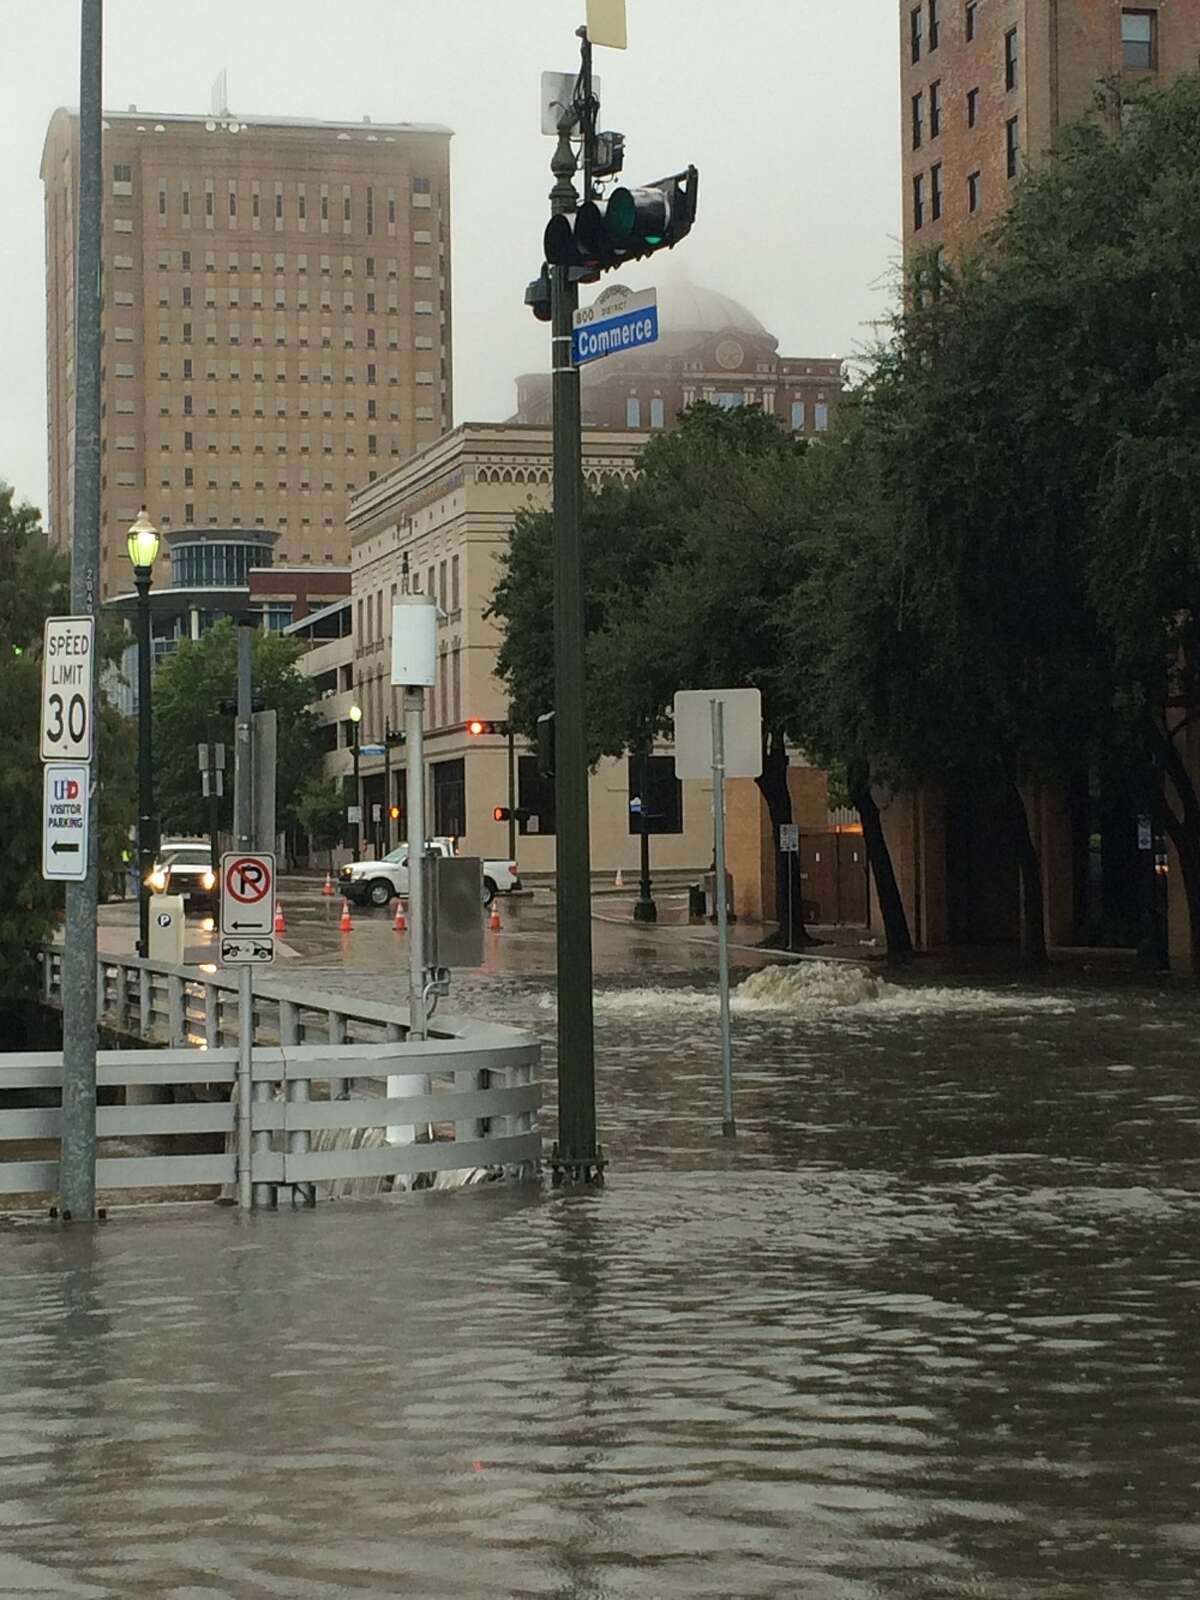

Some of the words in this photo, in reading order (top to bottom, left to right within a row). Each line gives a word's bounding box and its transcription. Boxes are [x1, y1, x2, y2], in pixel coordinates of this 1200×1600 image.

[576, 309, 594, 325] 800
[578, 318, 652, 356] Commerce
[49, 635, 89, 656] SPEED
[52, 664, 83, 685] LIMIT
[47, 693, 86, 743] 30
[50, 804, 82, 814] VISITOR
[48, 817, 83, 828] PARKING
